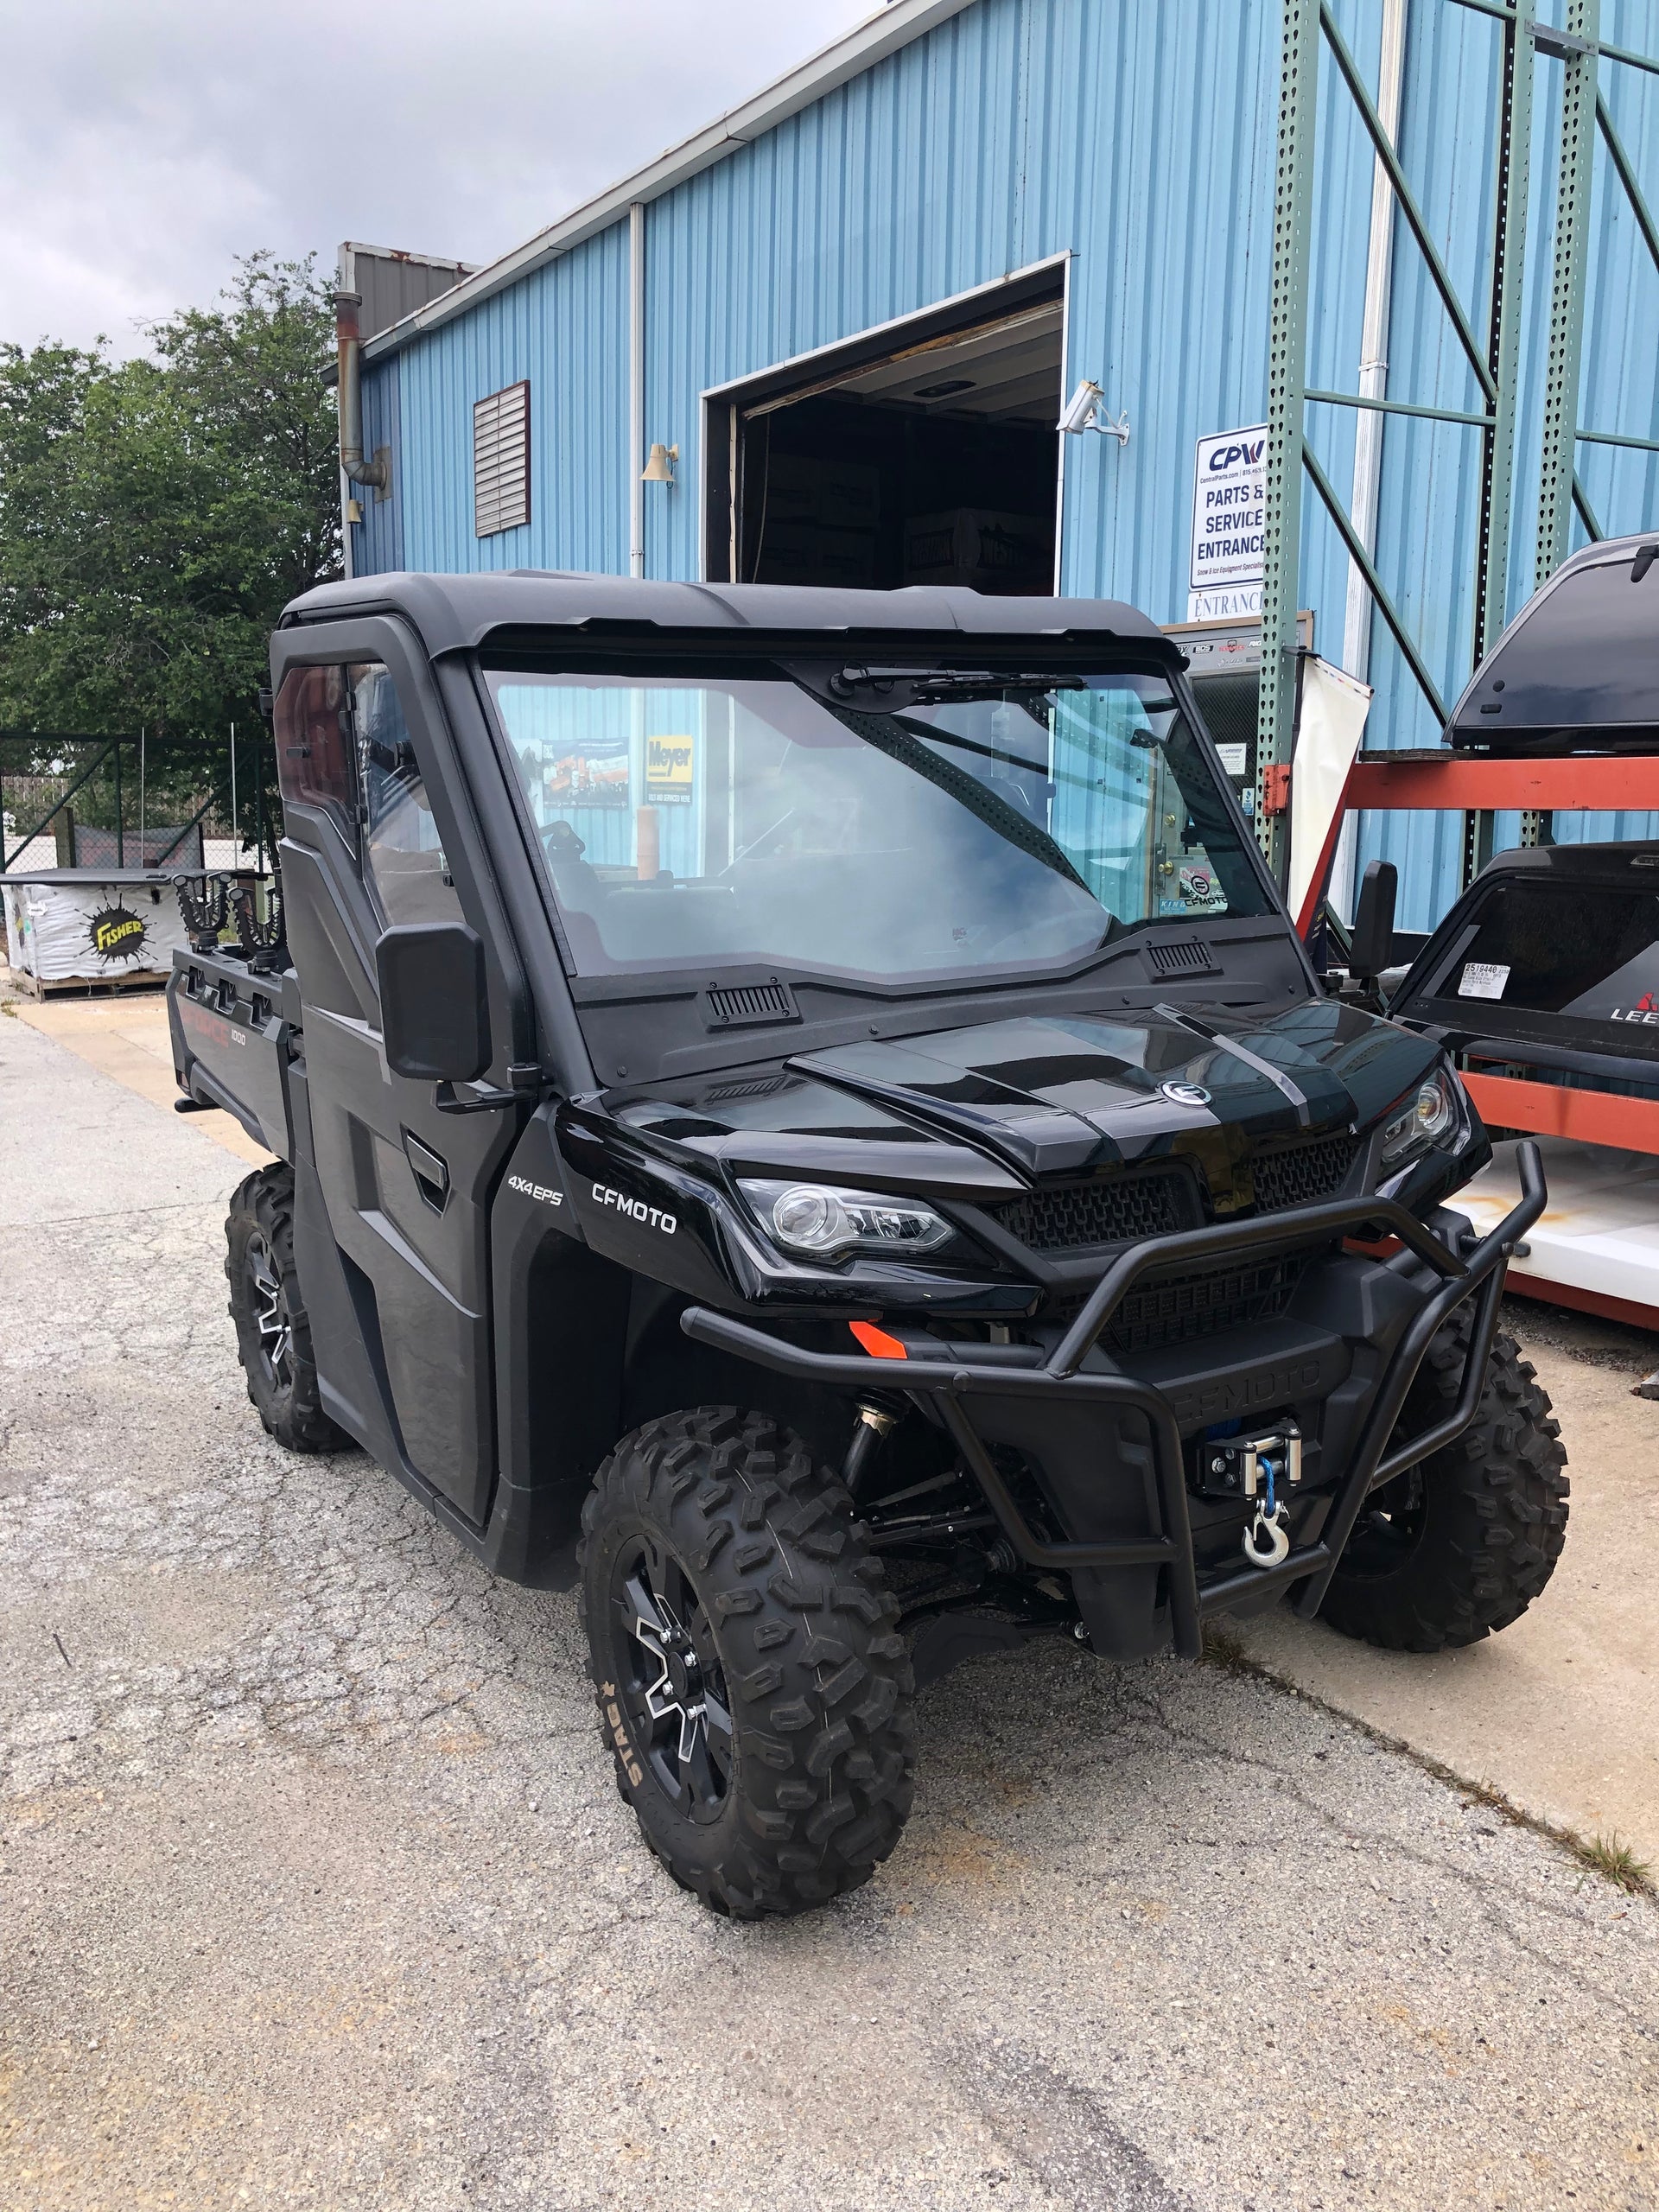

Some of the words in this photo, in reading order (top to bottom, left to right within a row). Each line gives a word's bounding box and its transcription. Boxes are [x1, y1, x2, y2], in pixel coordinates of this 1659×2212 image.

[1209, 440, 1265, 472] CPW
[1199, 472, 1239, 484] CentralParts.com
[1206, 485, 1249, 508] PARTS
[1254, 484, 1264, 499] &
[1205, 508, 1263, 534] SERVICE
[1243, 561, 1264, 570] Specialist
[648, 741, 691, 777] Meyer
[97, 920, 143, 951] FISHER
[1610, 1008, 1659, 1024] LEE
[231, 1028, 246, 1046] 1000
[592, 1183, 677, 1235] CFMOTO
[1173, 1359, 1320, 1424] CFMOTO
[606, 1702, 644, 1788] STAG
